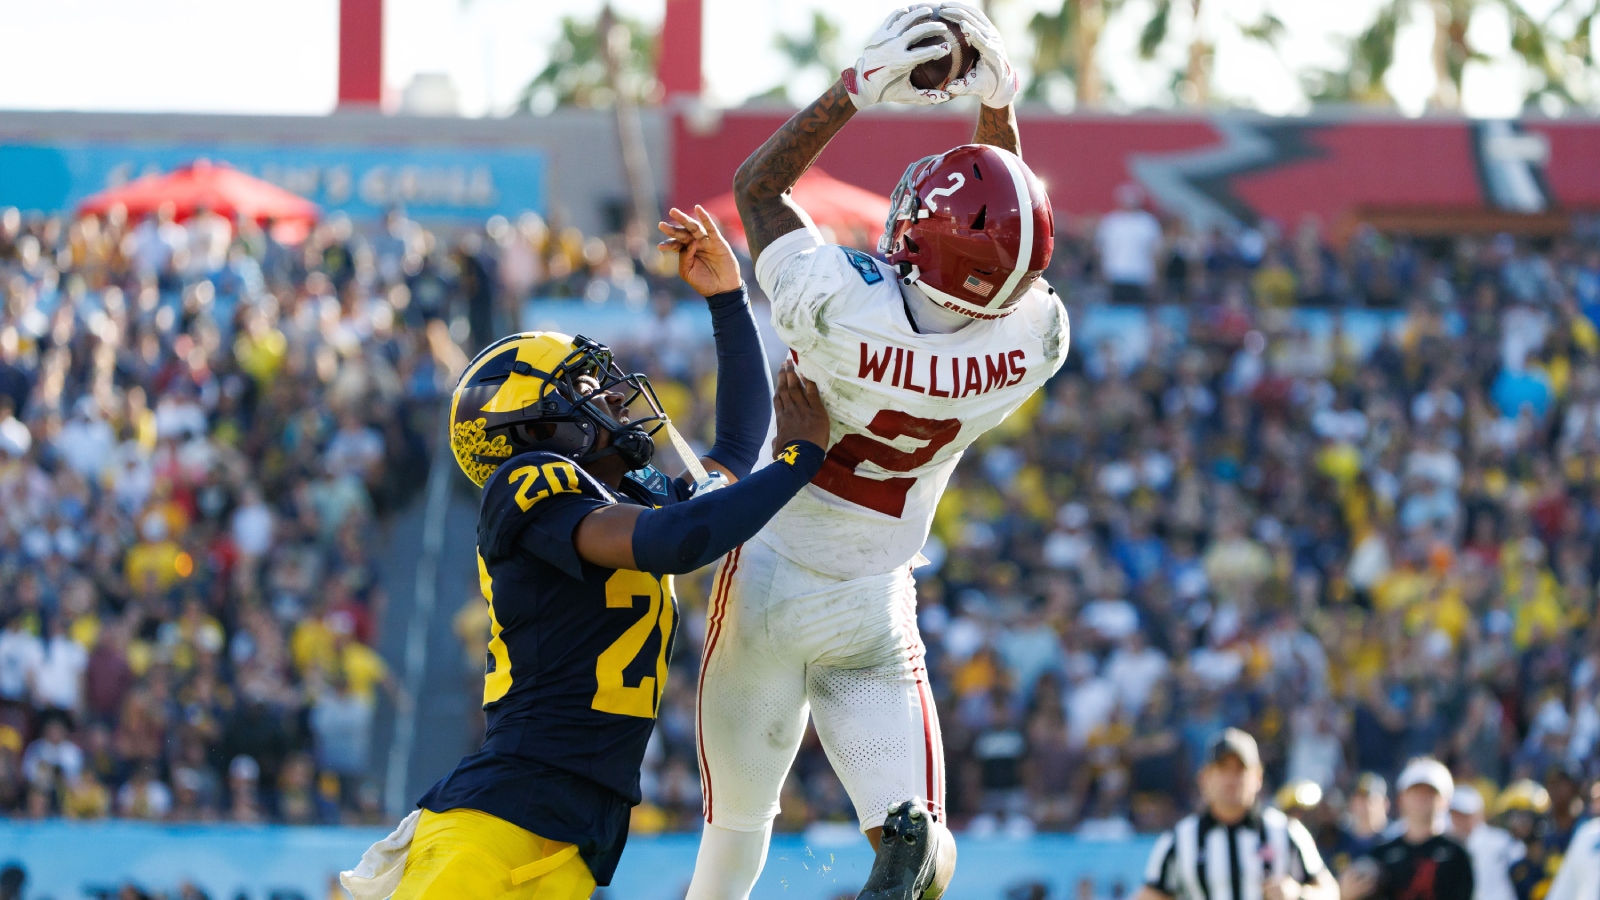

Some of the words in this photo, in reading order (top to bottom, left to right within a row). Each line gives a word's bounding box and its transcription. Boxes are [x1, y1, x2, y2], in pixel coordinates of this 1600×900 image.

[924, 172, 966, 213] 2
[943, 301, 999, 320] CRIMSON
[858, 342, 1027, 399] WILLIAMS
[508, 461, 582, 513] 20
[809, 409, 962, 519] 2
